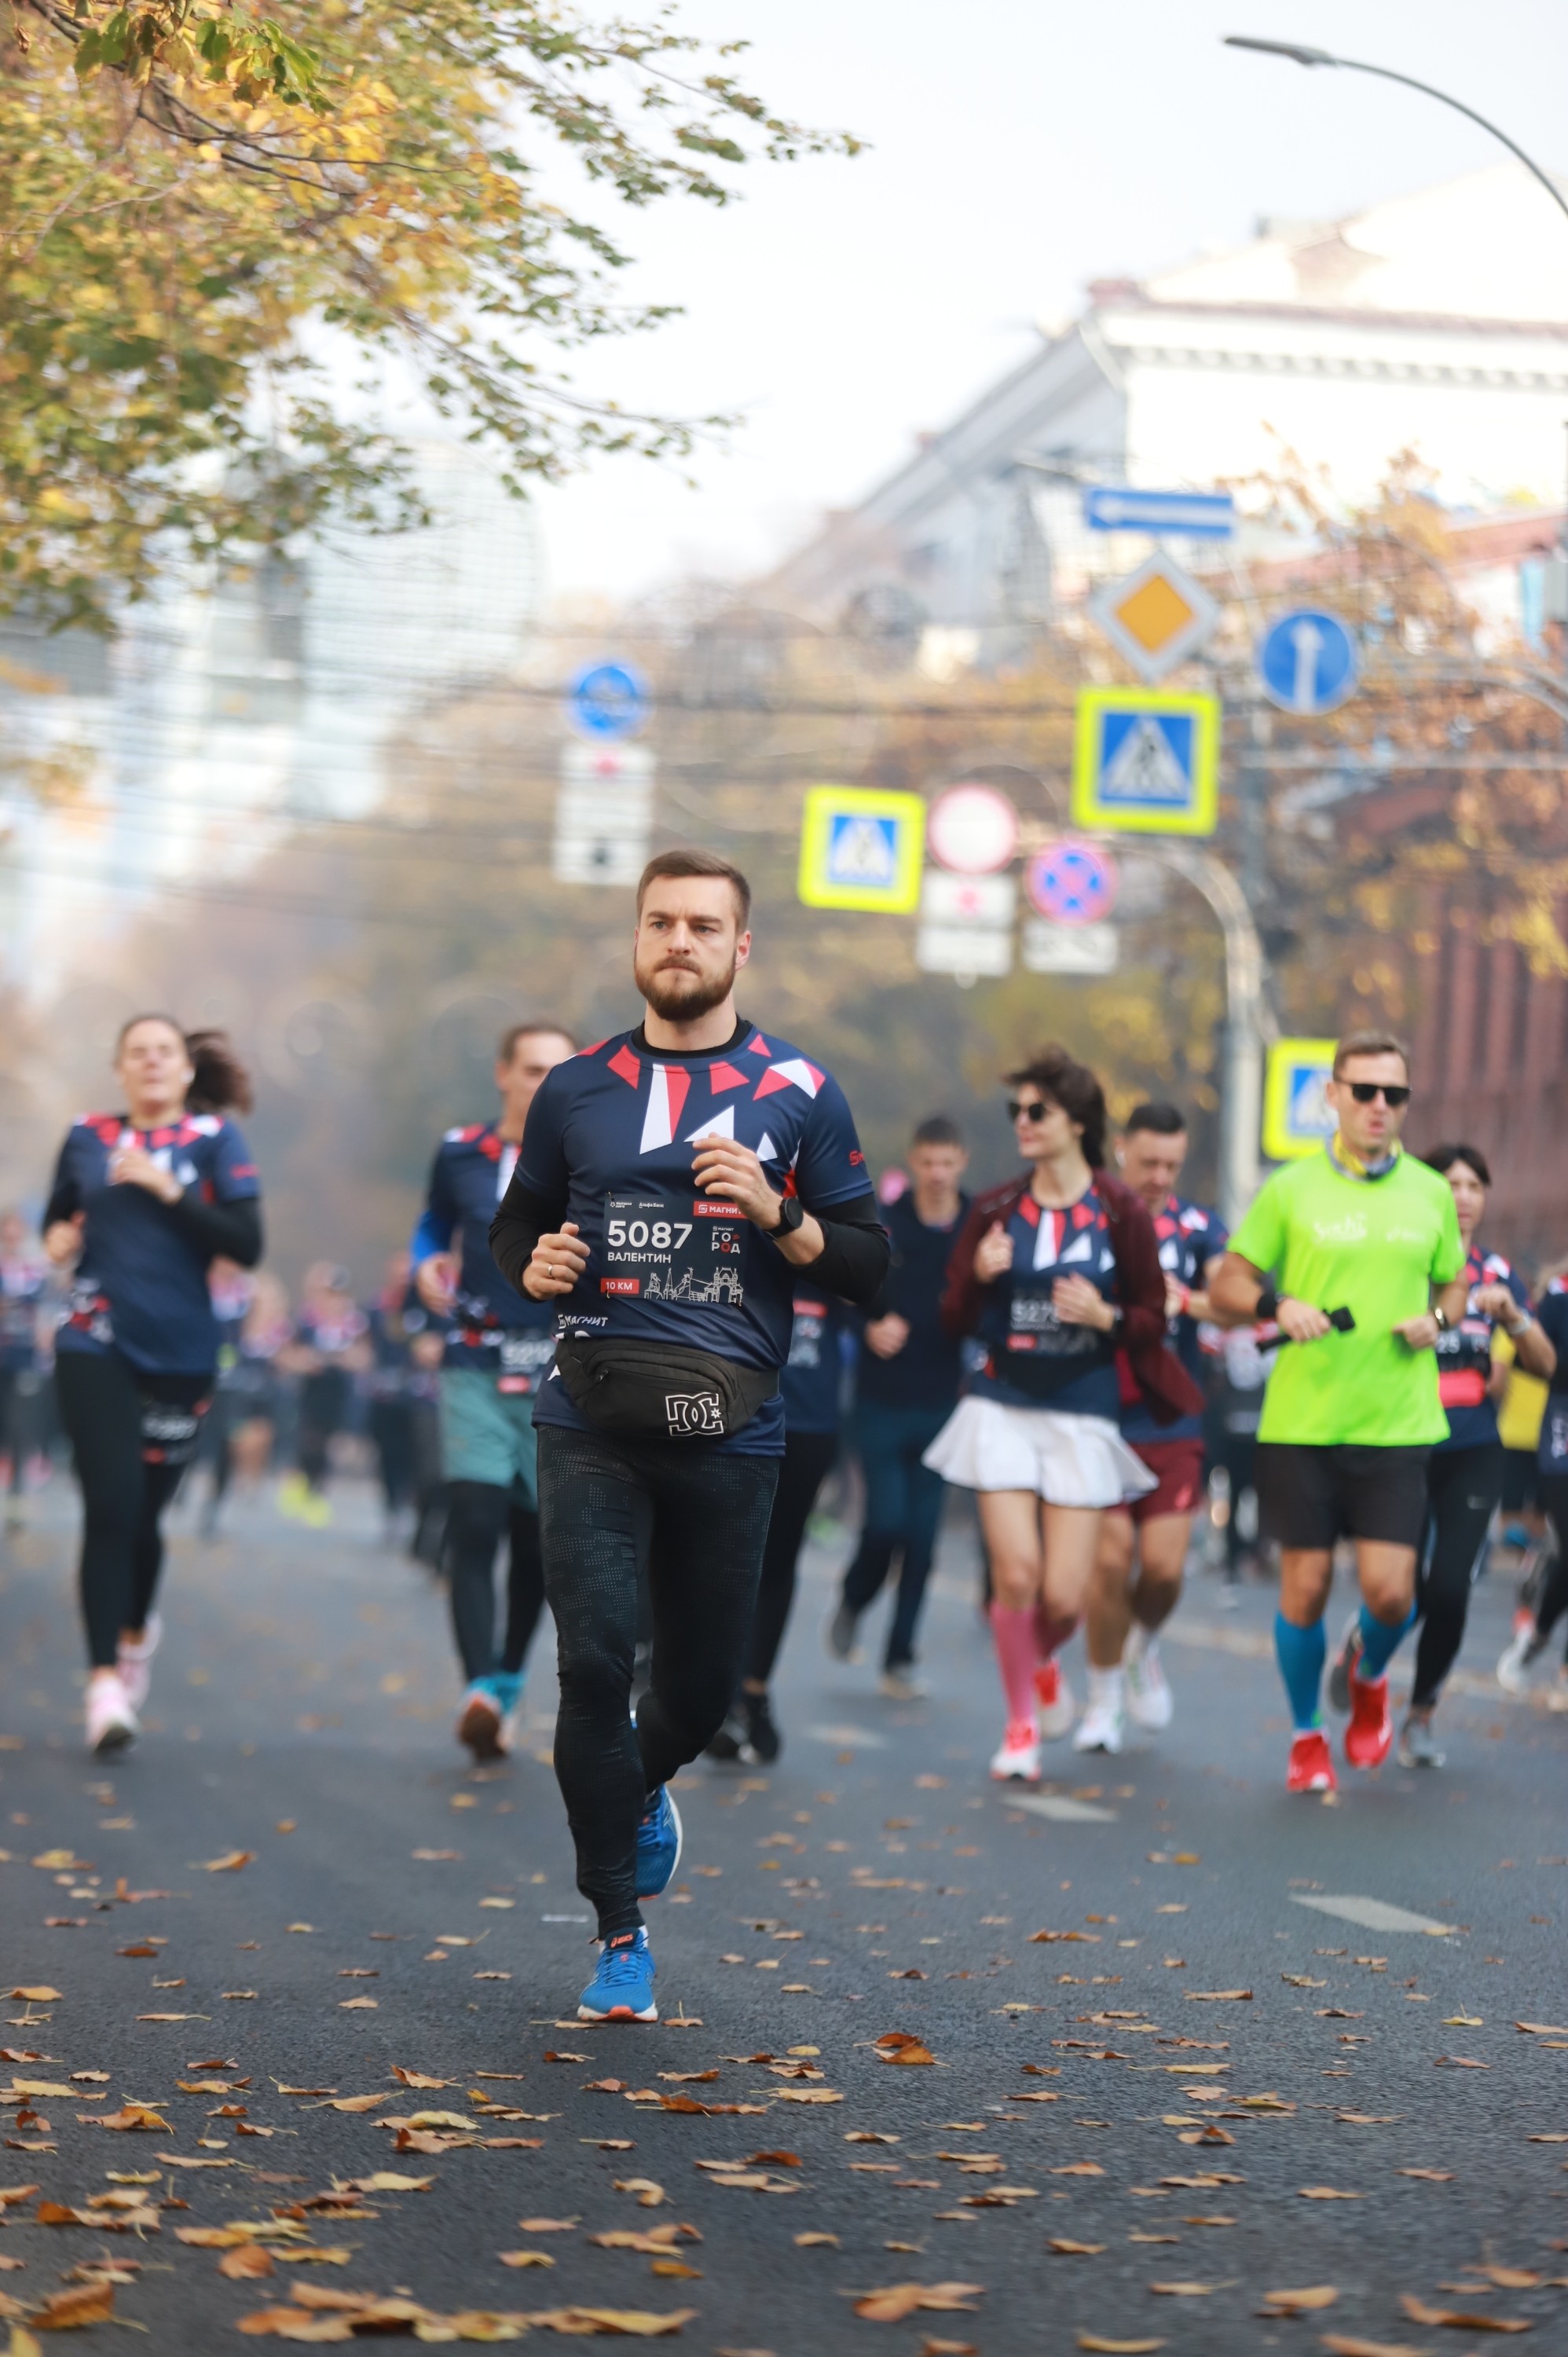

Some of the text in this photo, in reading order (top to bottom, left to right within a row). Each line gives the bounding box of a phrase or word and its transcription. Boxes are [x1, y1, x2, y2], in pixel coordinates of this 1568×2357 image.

[607, 1220, 693, 1249] 5087
[607, 1252, 672, 1264] ВАЛЕНТИН
[606, 1281, 616, 1290] 10
[565, 1315, 609, 1327] МАГНИТ
